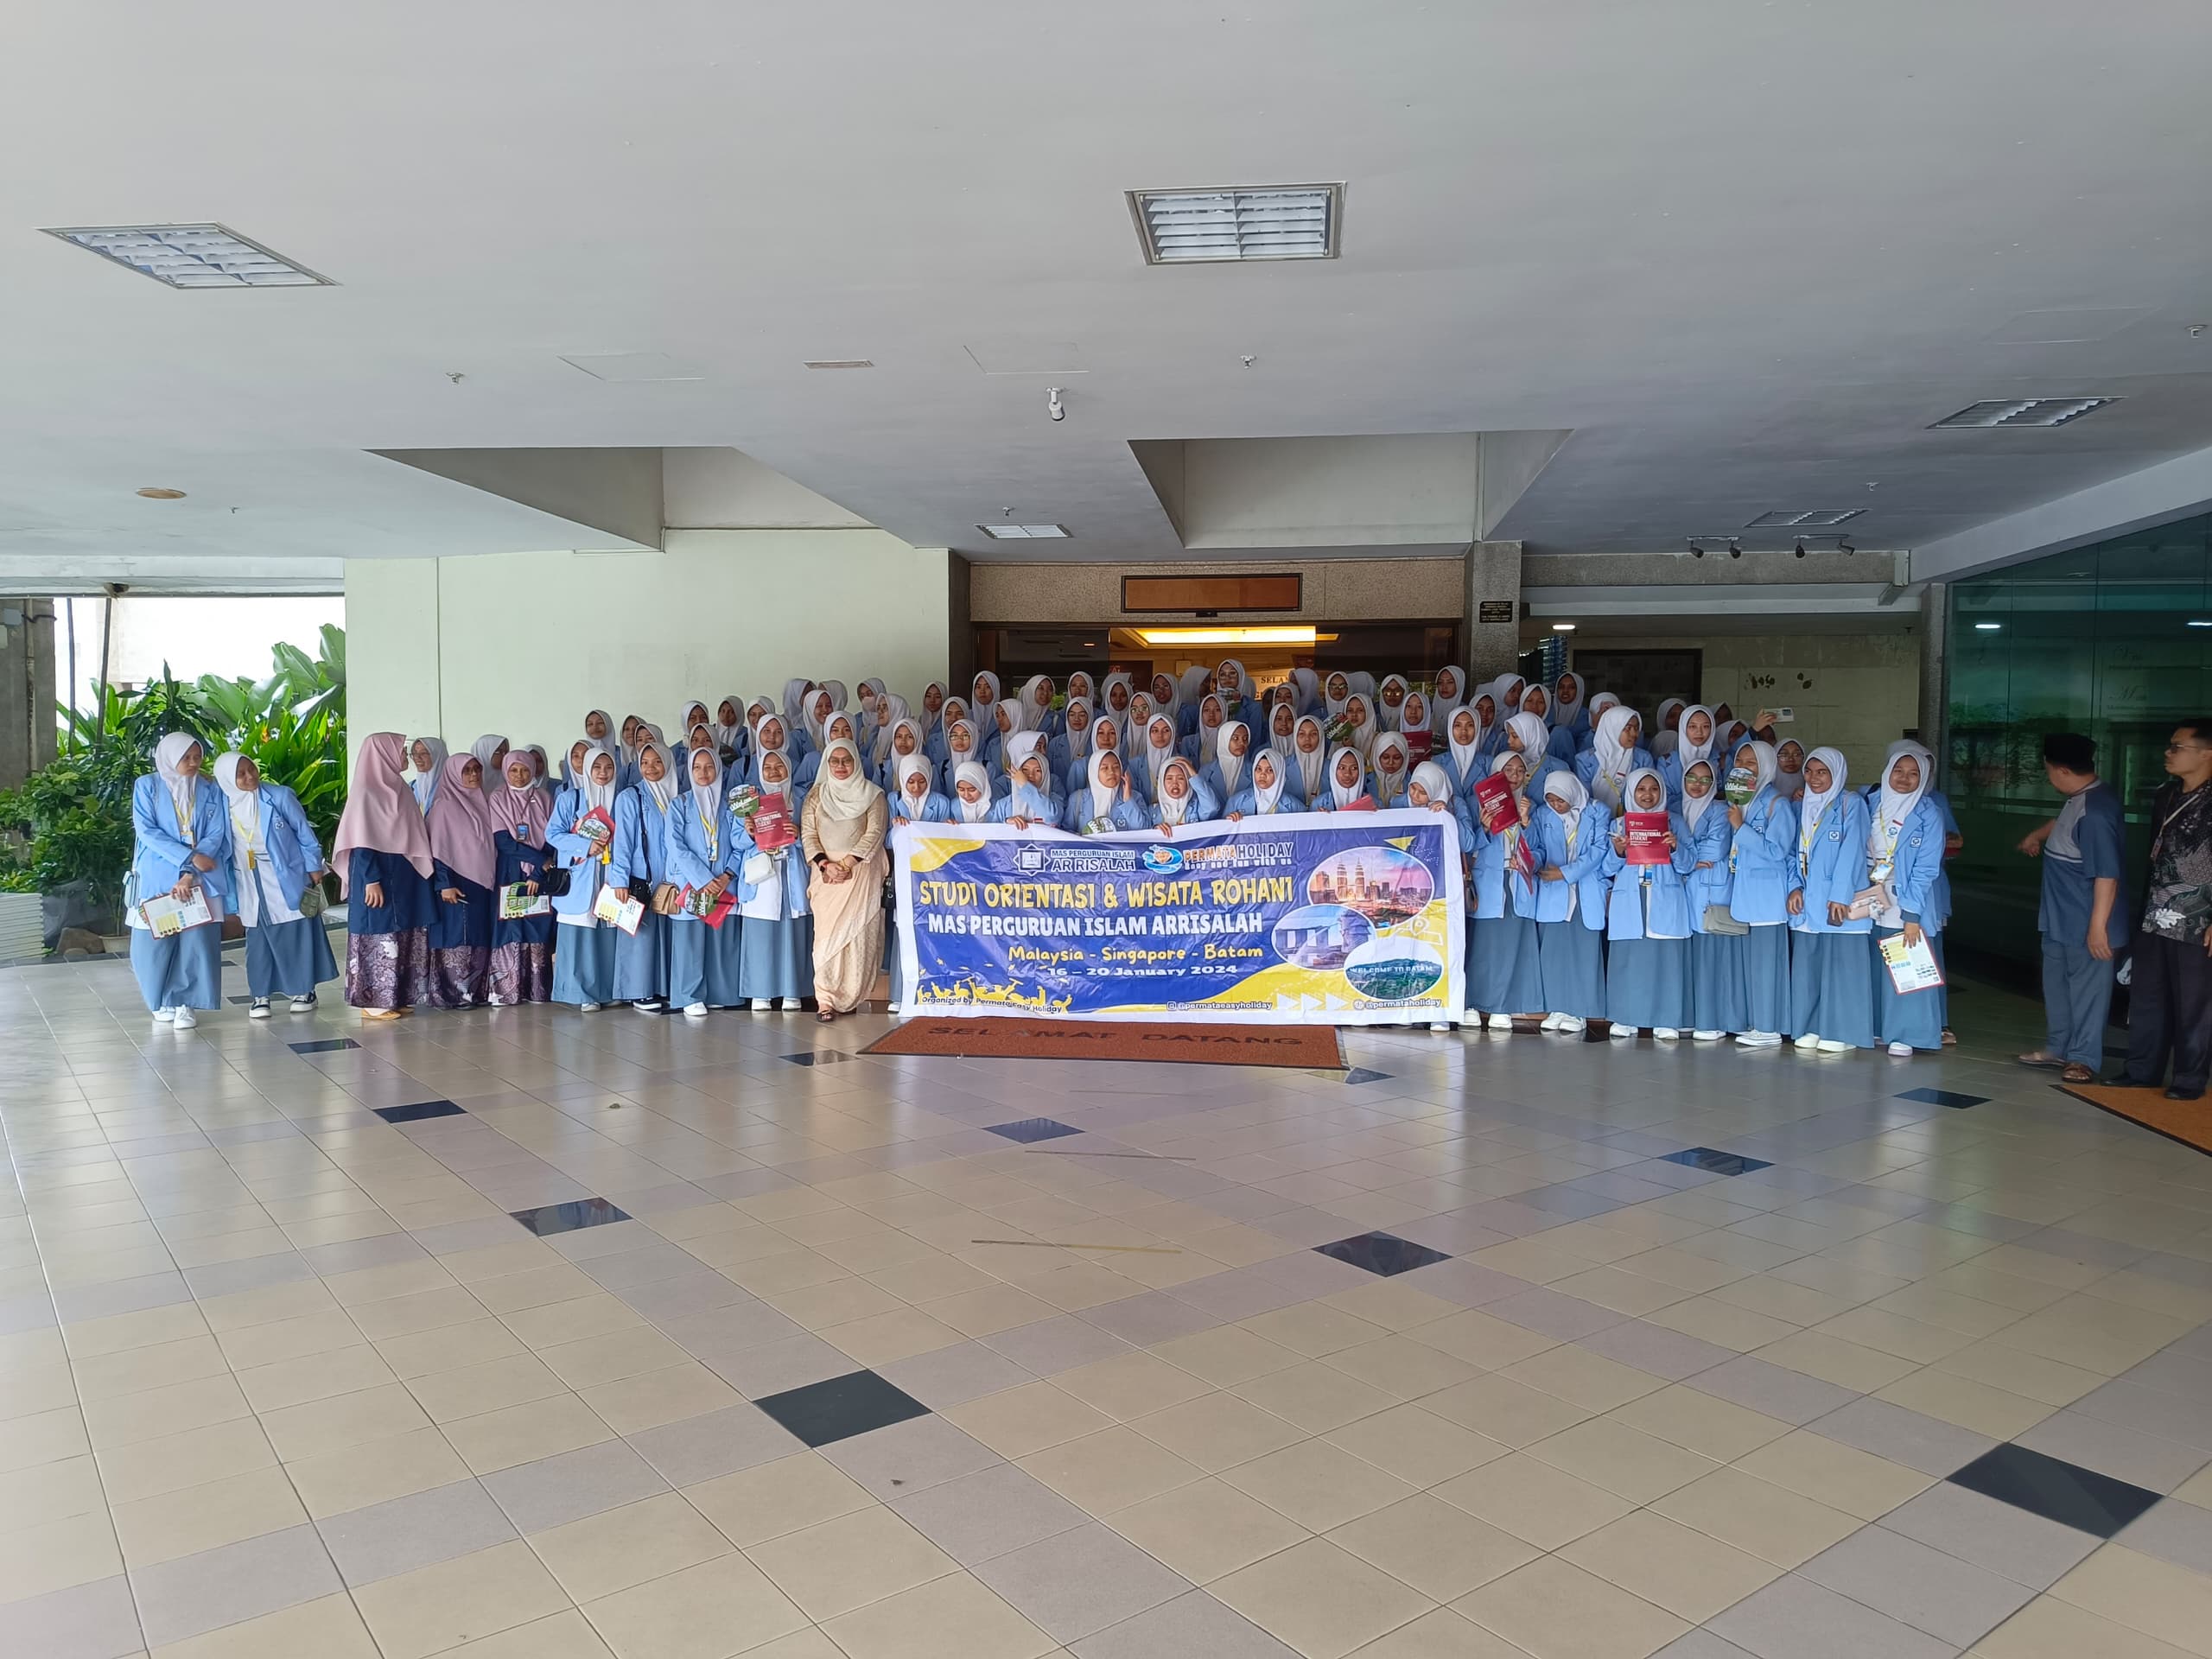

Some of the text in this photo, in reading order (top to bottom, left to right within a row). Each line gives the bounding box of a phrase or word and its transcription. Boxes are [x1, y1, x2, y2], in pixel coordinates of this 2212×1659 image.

[1051, 849, 1068, 858] MAS
[1069, 849, 1111, 858] PERGURUAN
[1051, 858, 1136, 872] AR RISALAH
[920, 876, 1294, 908] STUDI ORIENTASI & WISATA ROHANI
[928, 912, 1263, 937] MAS PERGURUAN ISLAM ARRISALAH
[1008, 946, 1084, 966] Malaysia
[1102, 946, 1185, 964] Singapore
[1205, 944, 1263, 958] Batam
[1047, 968, 1067, 976] 16
[1086, 968, 1112, 976] 20
[1113, 968, 1186, 979] January
[1191, 965, 1238, 976] 2024
[976, 999, 1012, 1007] Permata
[1033, 1005, 1063, 1014] Holiday
[1178, 1001, 1273, 1011] @permataeasyholiday
[1365, 998, 1442, 1009] @permataholiday
[1142, 1034, 1302, 1045] DATANG
